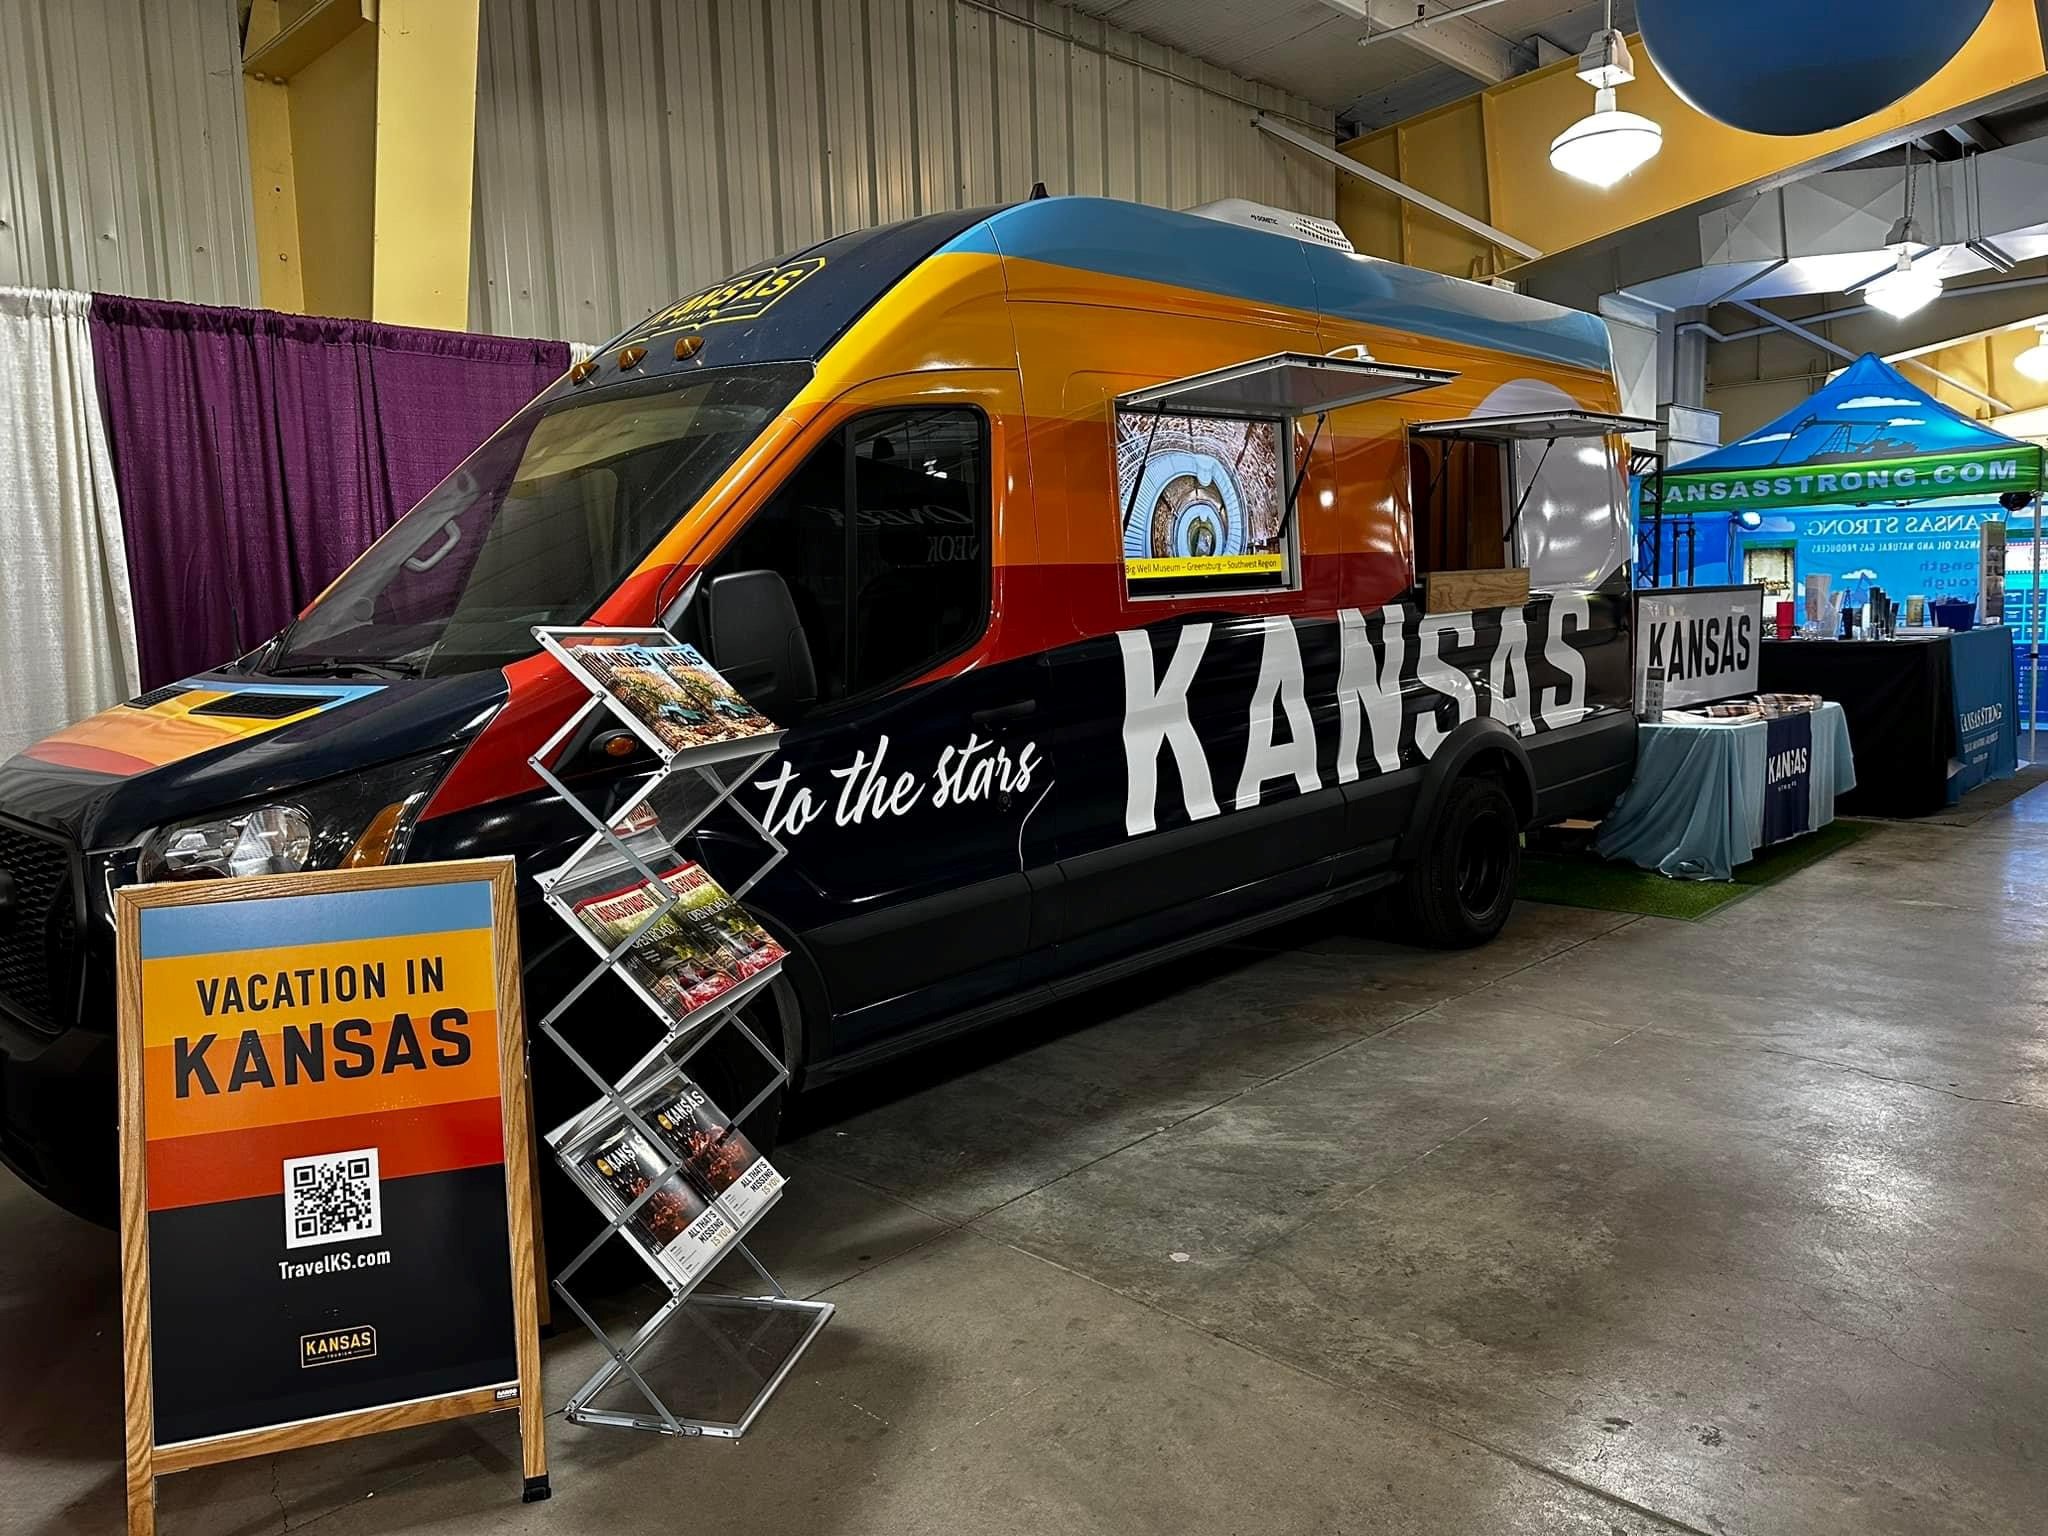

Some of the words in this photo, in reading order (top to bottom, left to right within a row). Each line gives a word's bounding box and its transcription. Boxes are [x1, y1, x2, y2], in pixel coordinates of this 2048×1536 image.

[1137, 564, 1151, 574] Well
[1152, 563, 1181, 573] Museum
[1187, 561, 1222, 572] Greensburg
[1227, 560, 1257, 570] Southwest
[1258, 559, 1277, 569] Region
[592, 651, 652, 668] KANSAS
[1649, 615, 1751, 683] KANSAS
[1116, 594, 1592, 836] KANSAS
[754, 761, 827, 840] to
[830, 735, 926, 827] the
[932, 733, 1043, 808] stars
[196, 962, 388, 1017] VACATION
[406, 956, 445, 994] IN
[174, 1007, 473, 1099] KANSAS
[664, 1091, 705, 1127] KANSAS
[750, 1168, 774, 1193] MISSING
[698, 1219, 724, 1244] MISSING
[278, 1249, 391, 1281] TravelKS.com
[306, 1332, 371, 1356] KANSAS
